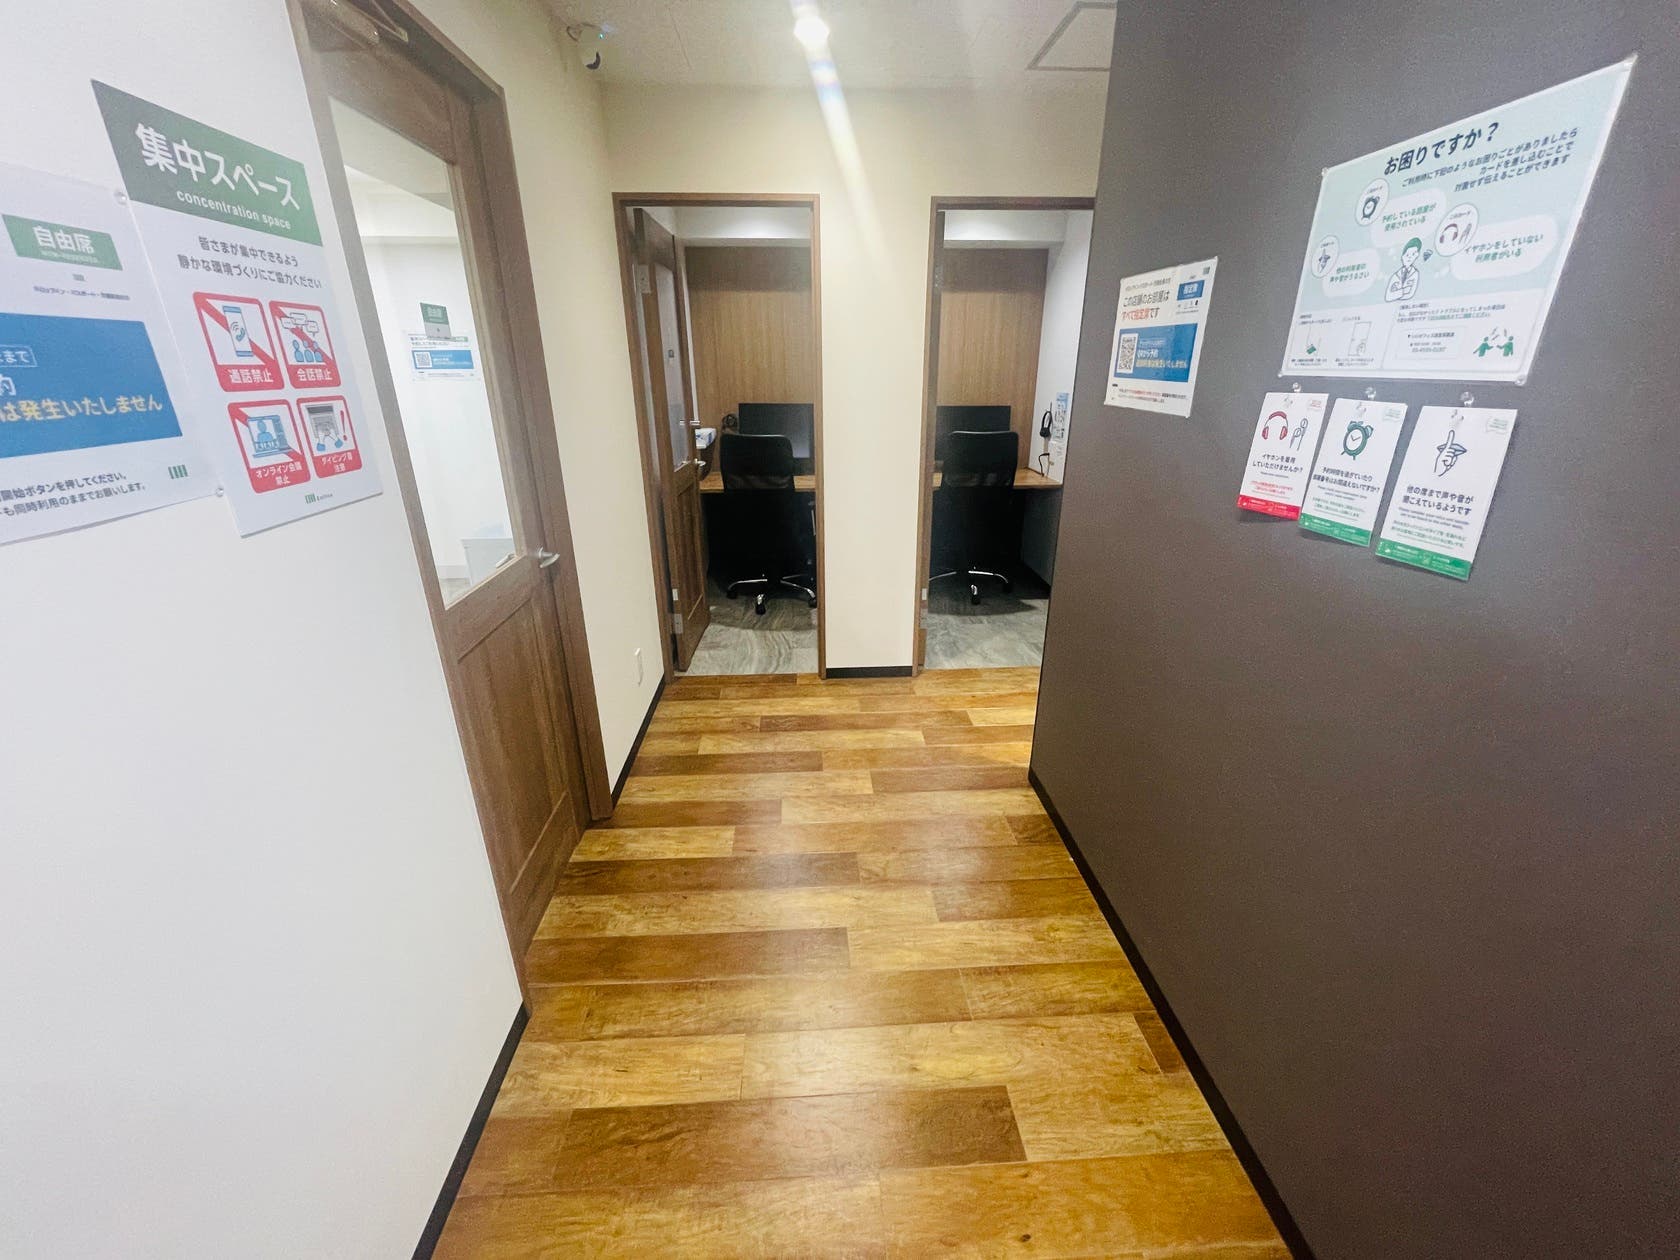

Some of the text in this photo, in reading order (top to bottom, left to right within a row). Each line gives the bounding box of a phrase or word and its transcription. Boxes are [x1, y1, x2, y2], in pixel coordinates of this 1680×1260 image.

[1383, 121, 1500, 176] お困りですか？
[135, 122, 300, 211] 集中スペース
[176, 189, 291, 230] concentration space
[32, 225, 95, 254] 自由席
[198, 236, 298, 267] 皆さまが集中できるよう
[177, 254, 322, 289] 静かな環境づくりにご協力ください
[0, 350, 29, 363] まで
[227, 368, 274, 384] 通話禁止
[297, 368, 333, 382] 会話禁止
[255, 461, 303, 479] オンライン会議
[275, 475, 291, 486] 禁止
[0, 472, 127, 502] 開始ボタンを押してください。
[0, 482, 146, 517] も同時利用のままでお願いします。
